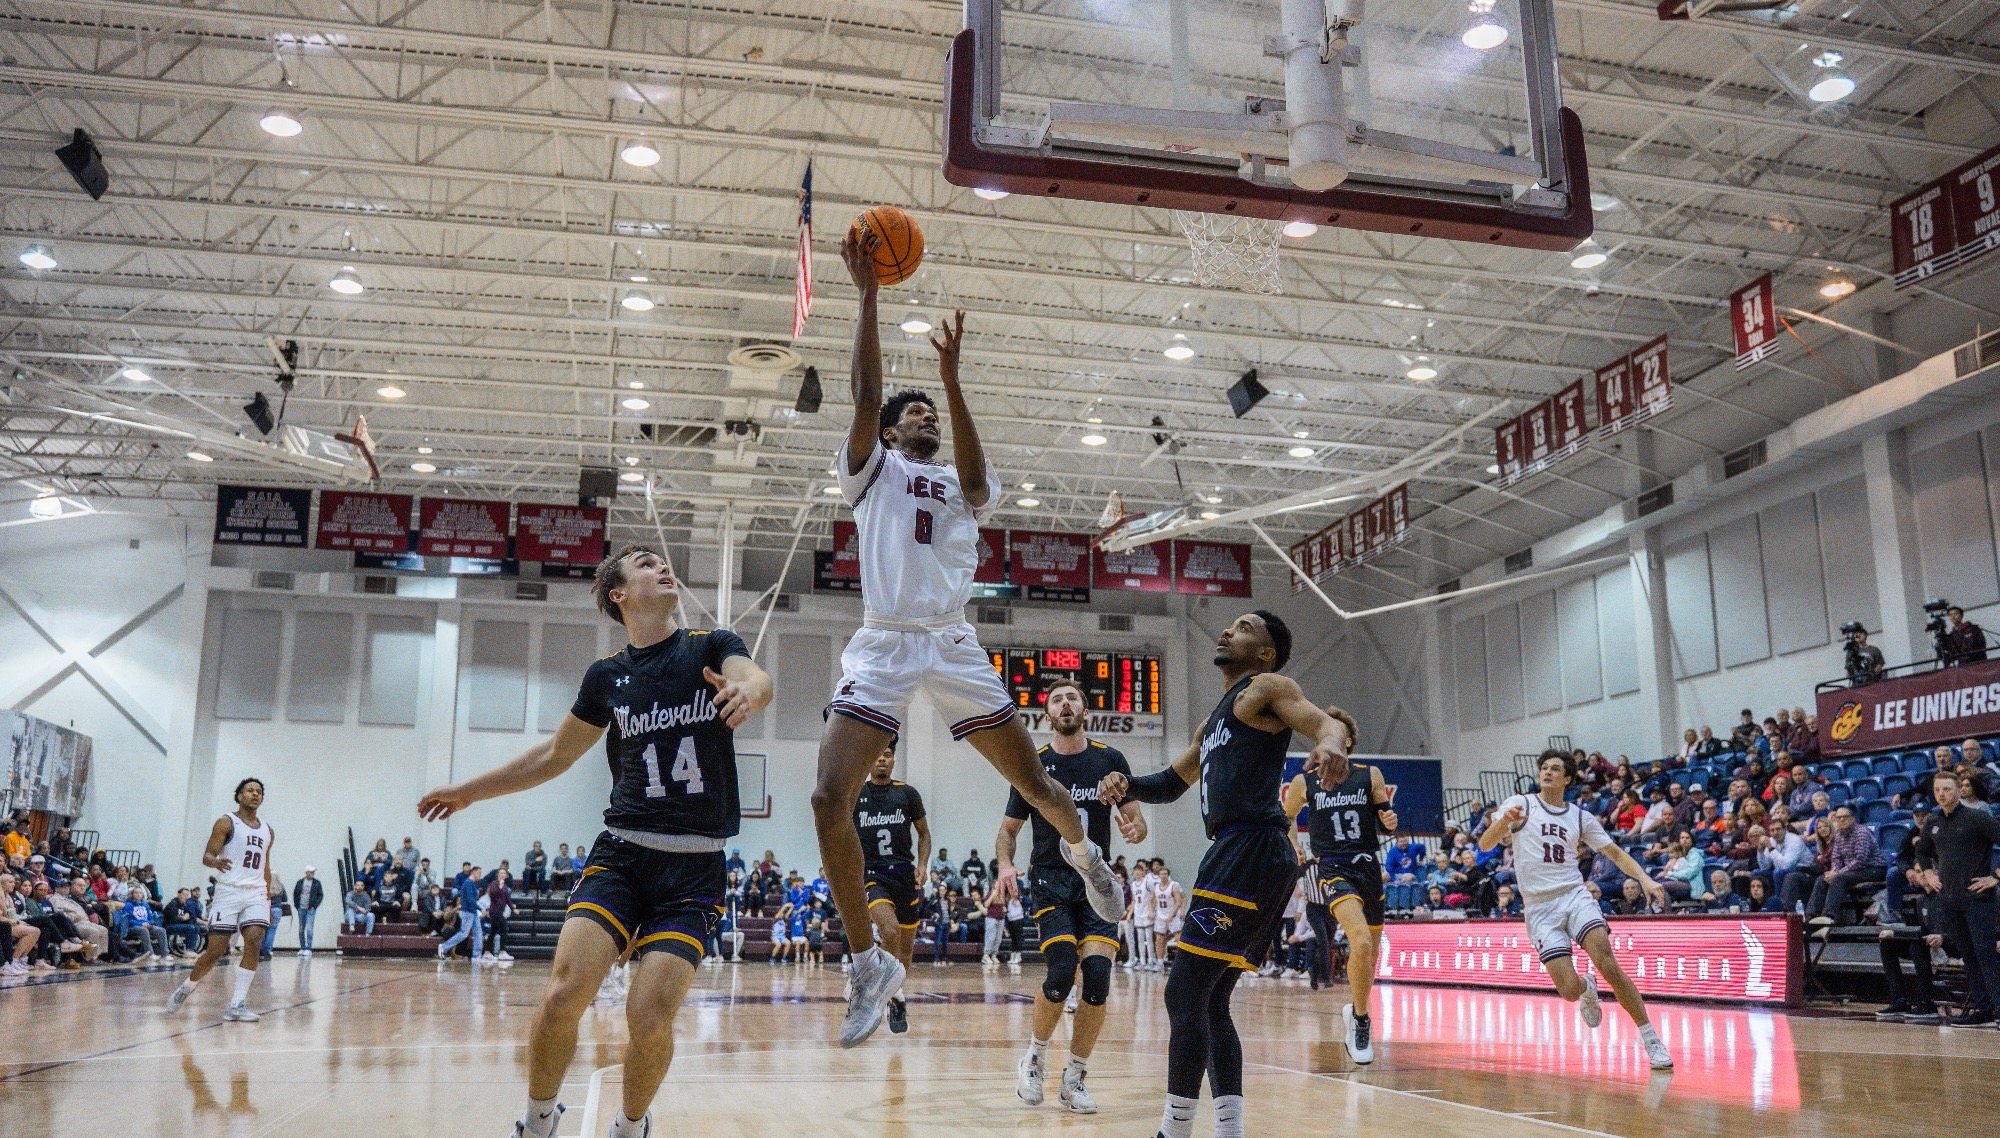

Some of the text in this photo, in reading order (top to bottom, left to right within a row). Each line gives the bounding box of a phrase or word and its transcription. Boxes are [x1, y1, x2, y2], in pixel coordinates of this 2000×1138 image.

[1977, 172, 1995, 213] 9
[1909, 203, 1934, 245] 18
[1742, 295, 1764, 333] 34
[1642, 355, 1661, 390] 22
[1606, 375, 1623, 406] 44
[1565, 400, 1575, 428] 5
[1533, 418, 1545, 448] 13
[915, 507, 933, 544] 0
[1024, 659, 1108, 679] 7 8
[1046, 650, 1080, 668] 14:26
[1134, 660, 1142, 670] 0
[1150, 660, 1158, 671] 5
[1134, 681, 1142, 691] 0
[1134, 692, 1142, 702] 0
[1019, 692, 1029, 706] 2
[1098, 695, 1104, 708] 1
[1118, 701, 1131, 713] 20
[1134, 702, 1142, 713] 0
[1874, 682, 2000, 731] LEE UNIVERS
[613, 689, 717, 739] Montevallo
[1081, 715, 1134, 733] AMES
[642, 736, 704, 797] 14
[1314, 788, 1367, 811] Montevallo
[859, 809, 905, 827] Montevallo
[1330, 810, 1362, 842] 13
[246, 835, 264, 850] LEE
[877, 829, 893, 856] 2
[1541, 823, 1568, 841] LEE
[243, 850, 261, 870] 20
[1542, 842, 1565, 864] 10
[1637, 956, 1731, 981] ARENA
